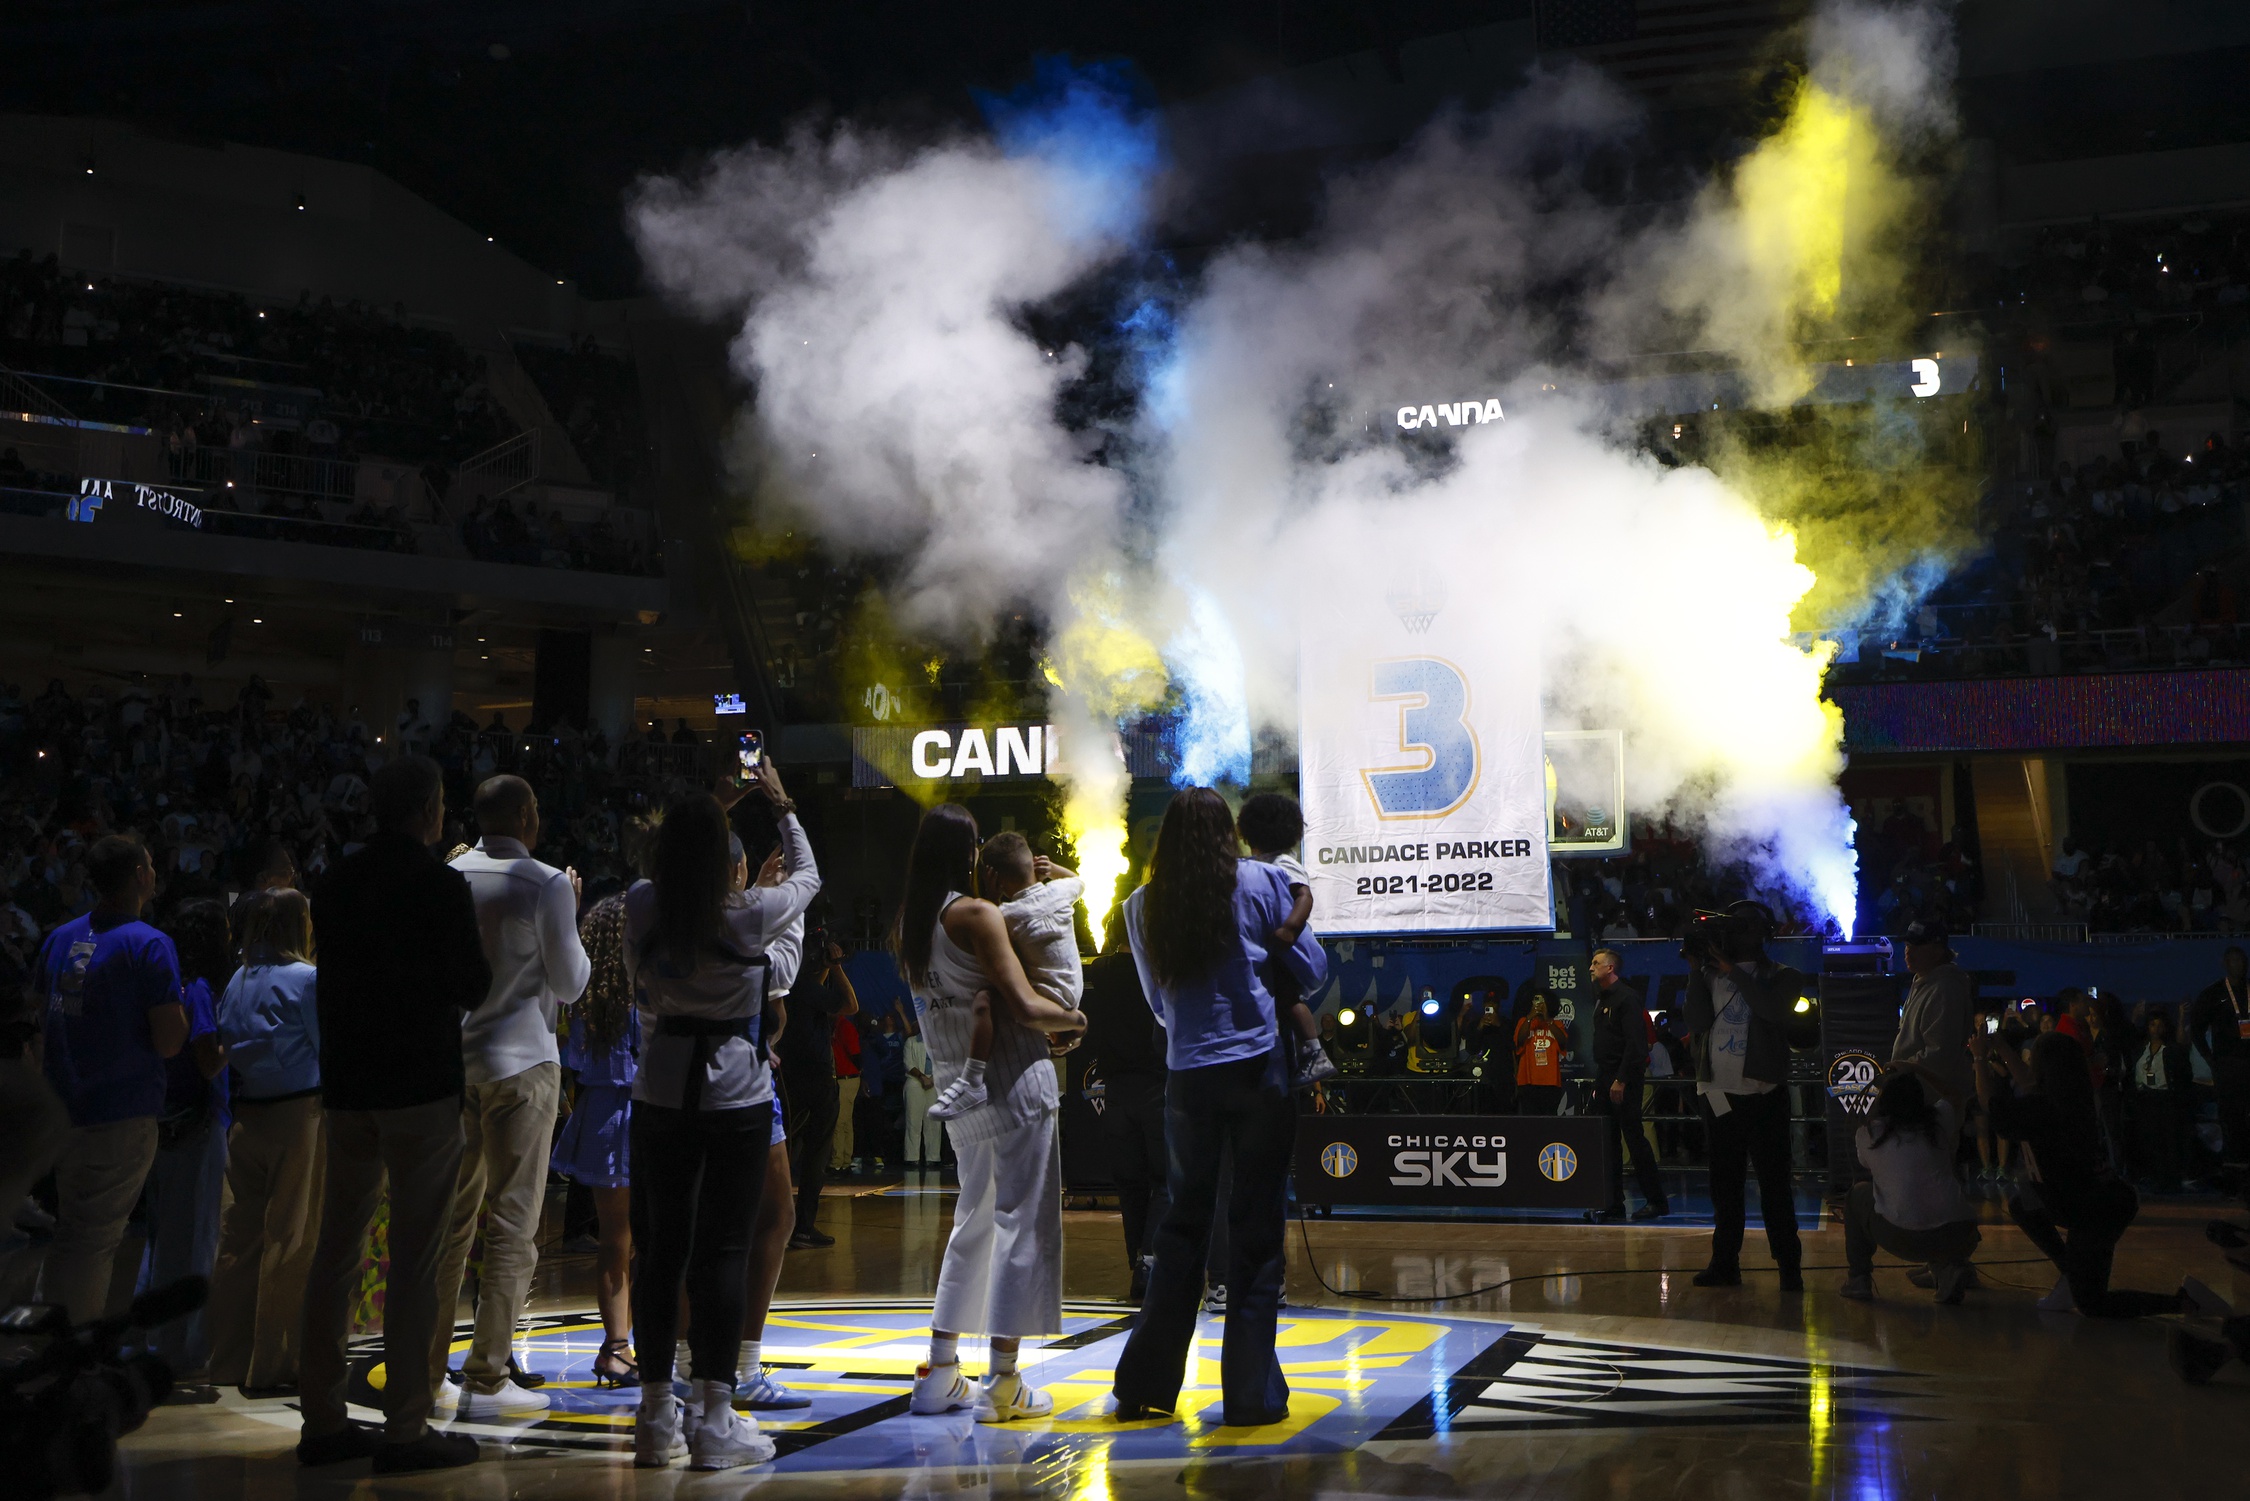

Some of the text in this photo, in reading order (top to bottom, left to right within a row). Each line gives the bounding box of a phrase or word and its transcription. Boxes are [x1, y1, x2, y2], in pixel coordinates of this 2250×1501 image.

[1911, 358, 1941, 398] 3
[1397, 398, 1506, 430] CANDA
[360, 627, 382, 642] 113
[430, 634, 453, 648] 114
[1359, 653, 1482, 822] 3
[1584, 827, 1608, 837] AT&T
[1318, 838, 1531, 865] CANDACE PARKER
[1356, 872, 1494, 896] 2021-2022
[1548, 965, 1576, 978] bet
[1548, 978, 1577, 990] 365
[1833, 1048, 1863, 1060] CHICAGO
[1837, 1060, 1875, 1085] 20
[1387, 1134, 1507, 1148] CHICAGO
[1388, 1150, 1508, 1188] SKY
